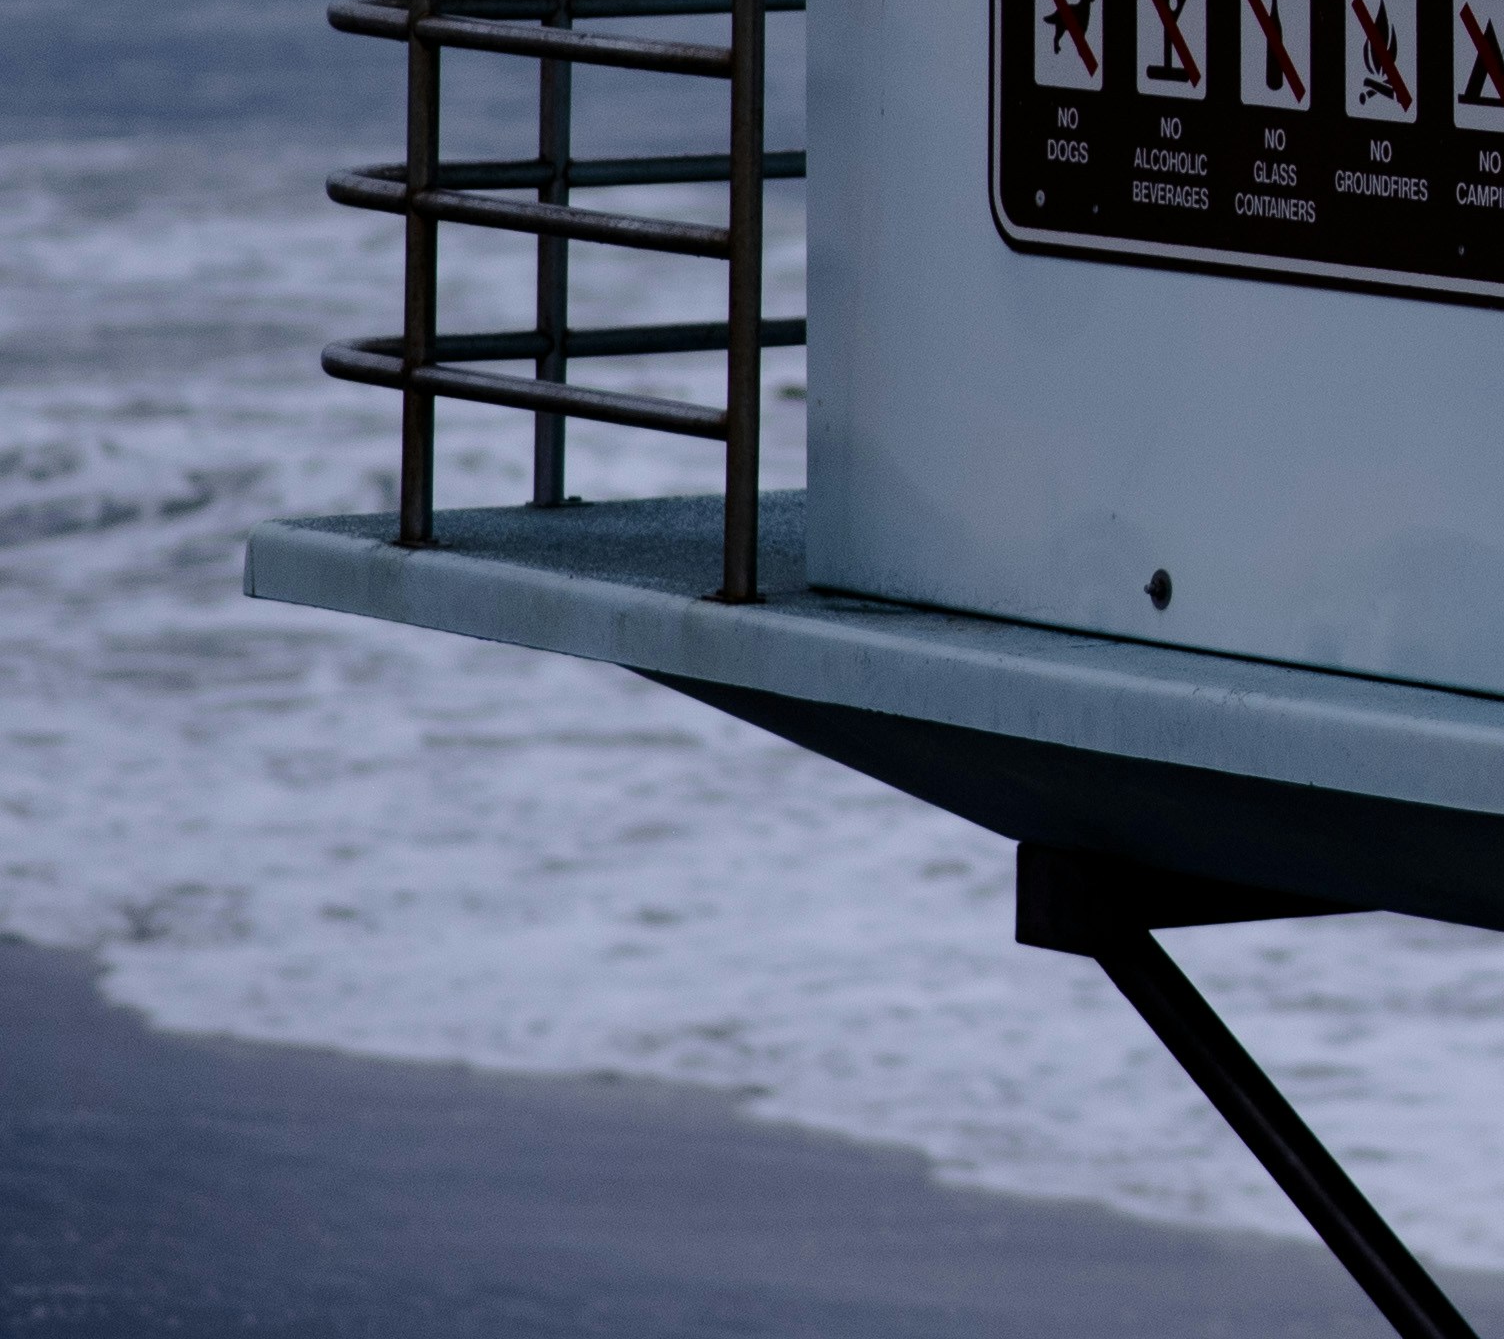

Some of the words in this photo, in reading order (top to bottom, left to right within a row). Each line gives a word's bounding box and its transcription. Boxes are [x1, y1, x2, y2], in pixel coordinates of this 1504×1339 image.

[1058, 107, 1078, 129] NO
[1161, 117, 1181, 139] NO
[1048, 139, 1088, 163] DOGS
[1265, 128, 1285, 150] NO
[1371, 140, 1392, 162] NO
[1134, 148, 1207, 175] ALCOHOLIC
[1254, 161, 1296, 186] GLASS
[1480, 151, 1501, 173] NO
[1133, 181, 1208, 209] BEVERAGES
[1335, 170, 1427, 201] GROUNDFIRES
[1235, 193, 1315, 222] CONTAINERS
